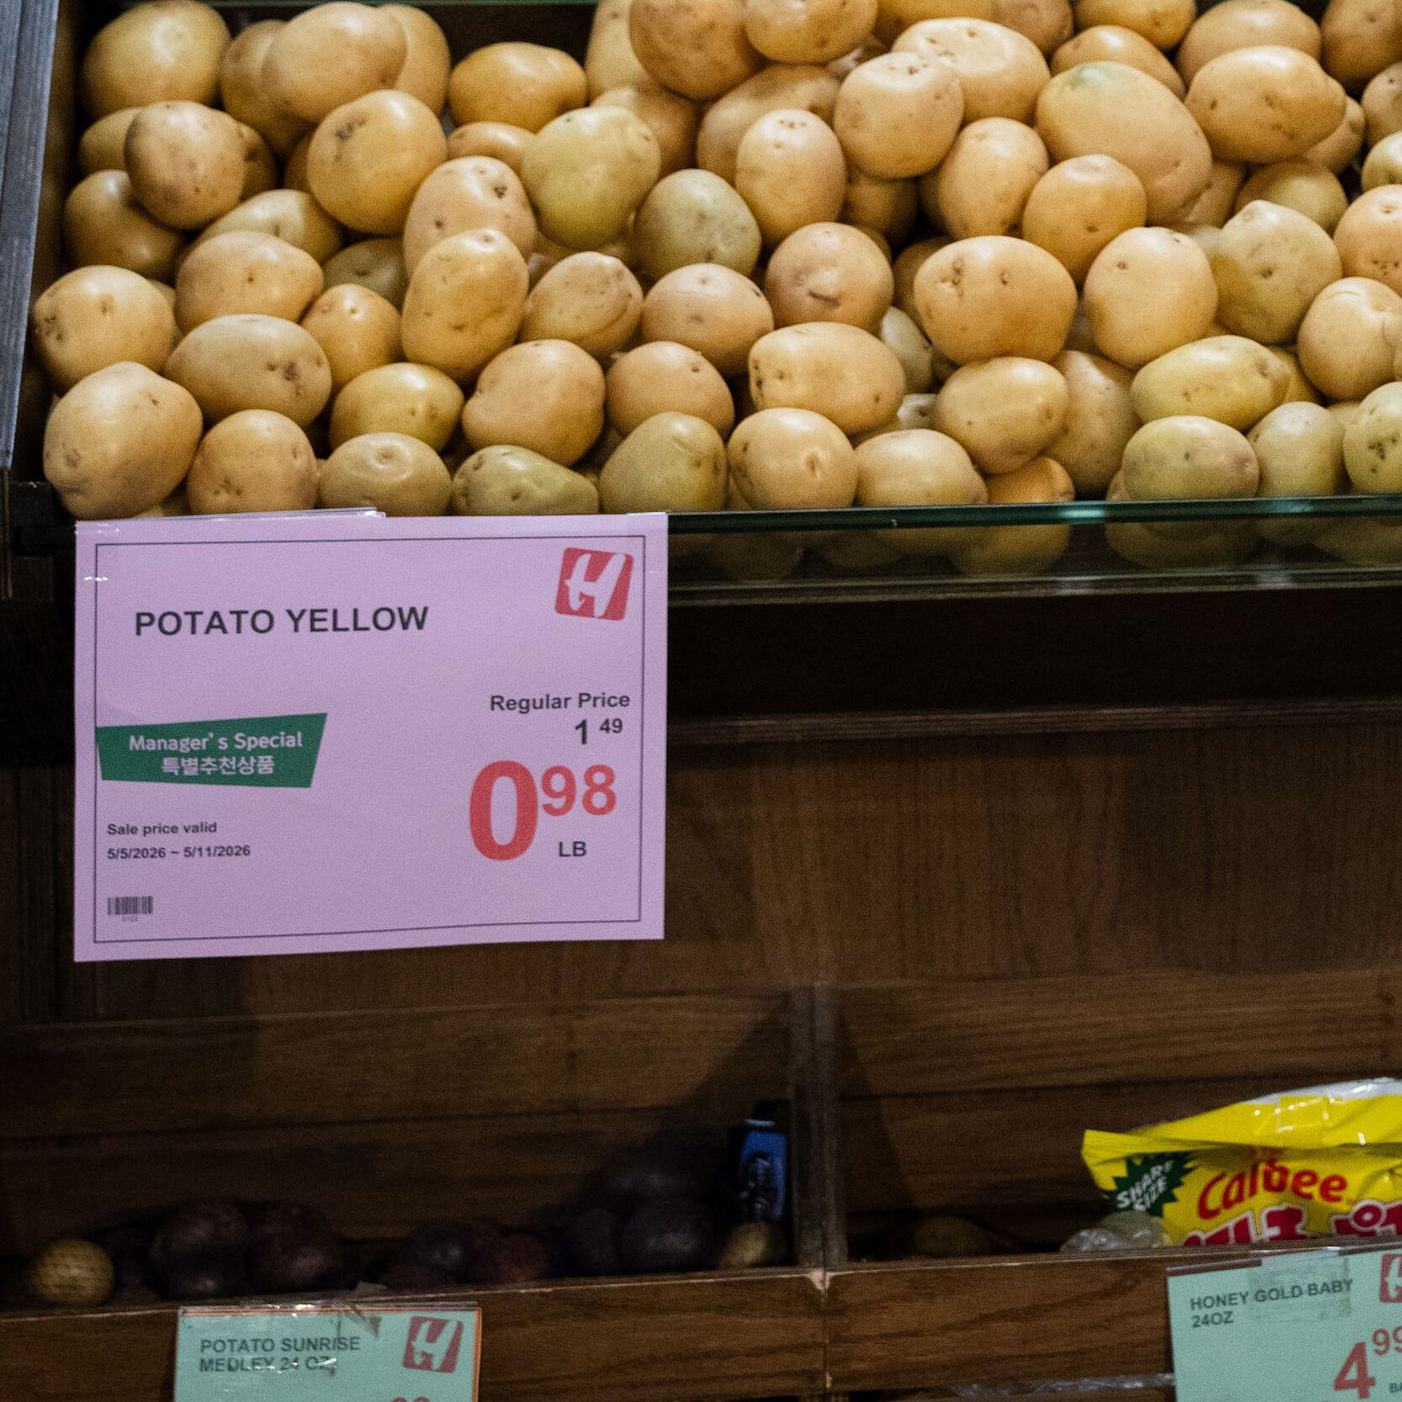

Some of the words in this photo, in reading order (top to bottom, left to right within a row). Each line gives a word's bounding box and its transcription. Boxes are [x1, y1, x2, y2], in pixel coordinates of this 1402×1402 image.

[134, 609, 275, 636] POTATO
[286, 605, 430, 633] YELLOW
[490, 694, 572, 715] Regular
[578, 692, 631, 709] Price
[234, 731, 303, 752] Special
[575, 720, 589, 745] 1
[600, 718, 623, 735] 49
[161, 755, 275, 776] 특별추천상품
[107, 823, 139, 836] Sale
[143, 823, 179, 838] price
[182, 821, 218, 834] valid
[107, 846, 167, 860] 5/5/2026
[183, 845, 251, 859] 5/11/2026
[558, 841, 588, 858] LB
[1197, 1158, 1347, 1220] Calbee
[1190, 1292, 1250, 1310] HONEY
[1254, 1285, 1304, 1303] GOLD
[1307, 1279, 1354, 1297] BABY
[1191, 1311, 1234, 1328] 24OZ
[200, 1338, 276, 1354] POTATO
[281, 1336, 361, 1352] SUNRISE
[200, 1356, 276, 1373] MEDLEY
[1333, 1341, 1376, 1400] 4
